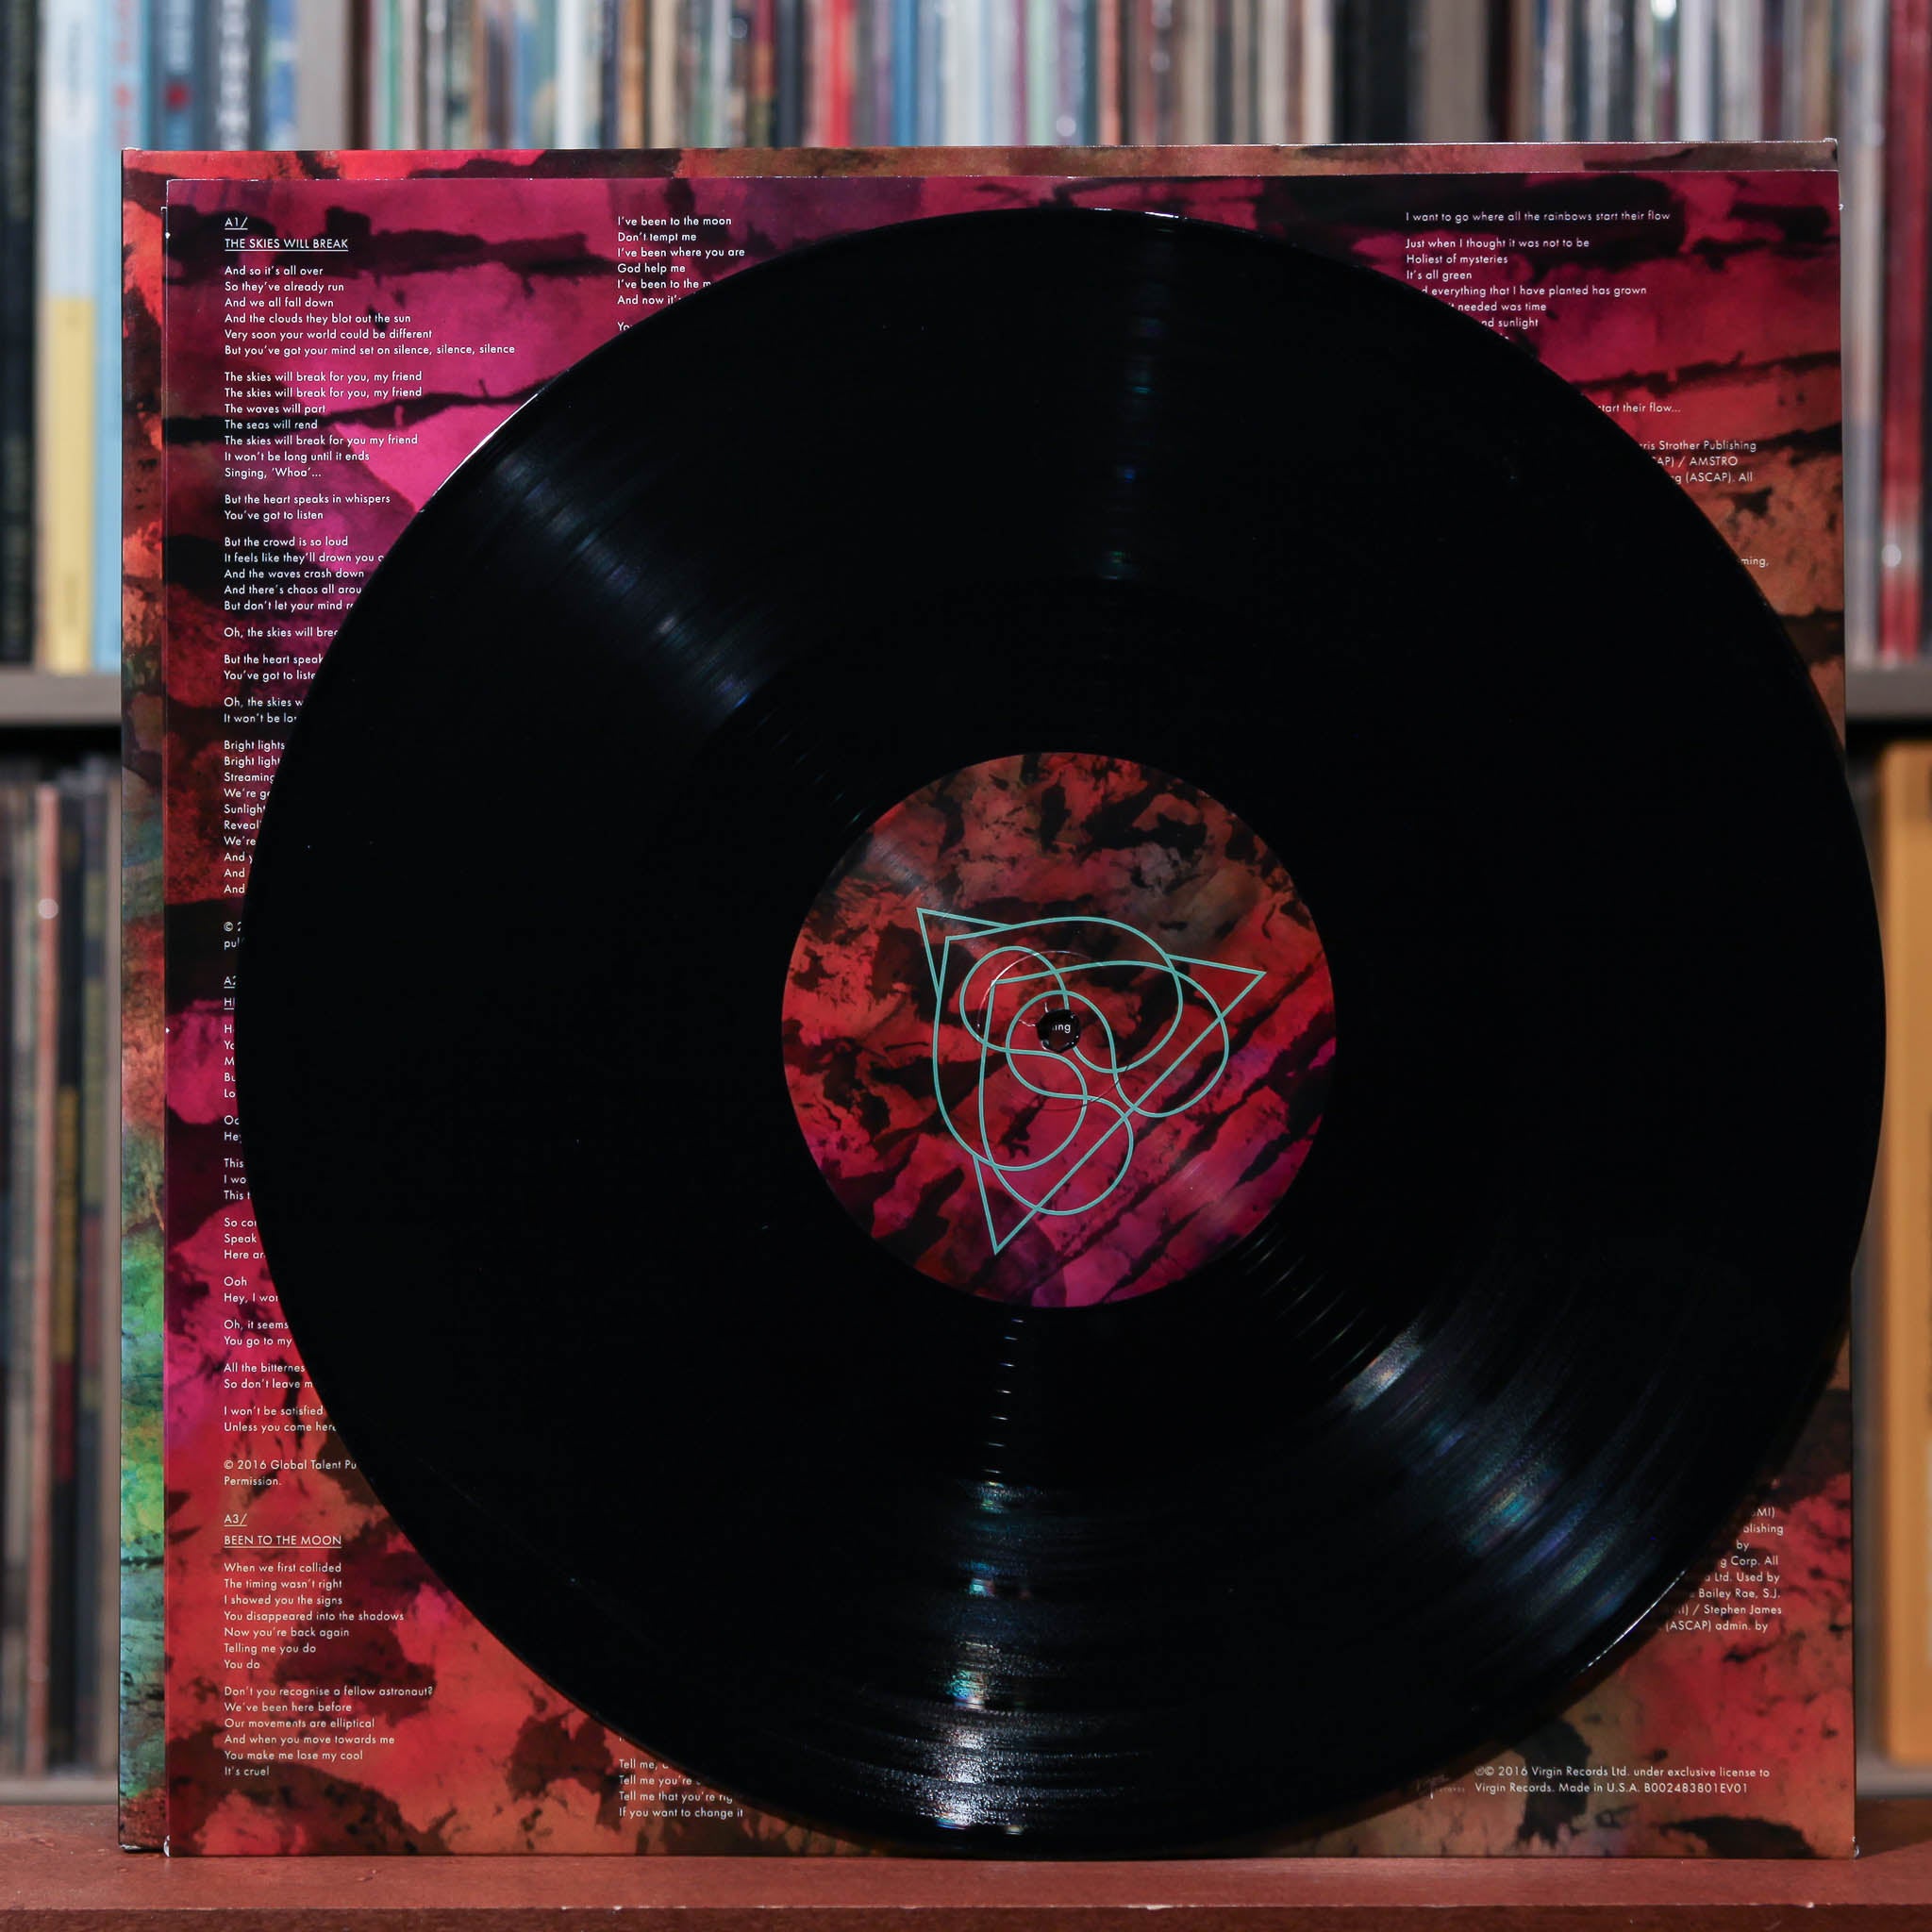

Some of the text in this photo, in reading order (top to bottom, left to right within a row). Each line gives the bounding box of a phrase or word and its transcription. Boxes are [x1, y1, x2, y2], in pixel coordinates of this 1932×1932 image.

[617, 215, 638, 226] I've
[641, 214, 667, 226] been
[670, 217, 681, 226] to
[683, 214, 700, 226] the
[1406, 208, 1671, 225] I want to go where all the rainbows start their flow
[224, 238, 348, 249] THE SKIES WILL BREAK
[1406, 252, 1508, 267] Holiest of mysteries
[224, 264, 246, 275] And
[264, 265, 281, 275] it's
[283, 264, 297, 276] all
[299, 268, 324, 276] over
[617, 262, 641, 274] God
[644, 261, 668, 276] help
[224, 280, 239, 291] So
[242, 280, 281, 294] they've
[283, 280, 325, 294] already
[1431, 284, 1647, 299] everything that I have planted has grown
[224, 311, 411, 326] And the clouds they blot out the sun
[1497, 316, 1539, 330] sunlight
[225, 342, 516, 358] But you've got your mind set on silence, silence, silence
[224, 370, 423, 385] The skies will break for you, my friend
[1623, 402, 1647, 413] their
[1658, 439, 1757, 454] Strother Publishing
[1689, 455, 1739, 467] AMSTRO
[224, 467, 268, 480] Singing,
[1738, 471, 1753, 482] All
[225, 492, 391, 507] But the heart speaks in whispers
[224, 567, 365, 579] And the waves crash down
[224, 739, 286, 753] Bright lights
[223, 787, 257, 798] We're
[224, 1232, 258, 1246] Speak
[223, 1275, 248, 1287] Ooh
[223, 1335, 292, 1349] You go to my
[224, 1404, 324, 1416] I won't be satisfied
[237, 1458, 267, 1470] 2016
[270, 1458, 308, 1471] Global
[309, 1458, 341, 1470] Talent
[224, 1474, 282, 1487] Permission.
[224, 1534, 341, 1546] BEEN TO THE MOON
[1730, 1555, 1779, 1569] Corp. All
[1698, 1587, 1732, 1601] Bailey
[1735, 1587, 1758, 1600] Rae,
[224, 1609, 405, 1624] You disappeared into the shadows
[1703, 1603, 1747, 1617] Stephen
[1748, 1604, 1782, 1616] James
[224, 1684, 434, 1699] Don't you recognise a fellow astronaut?
[224, 1716, 375, 1731] Our movements are elliptical
[1498, 1765, 1771, 1780] 2016 Virgin Records Ltd. under exclusive license to
[1474, 1782, 1507, 1795] Virgin
[1509, 1781, 1556, 1793] Records.
[1557, 1781, 1591, 1793] Made
[1593, 1782, 1604, 1793] in
[1607, 1782, 1641, 1793] U.S.A.
[619, 1806, 743, 1821] If you want to change it
